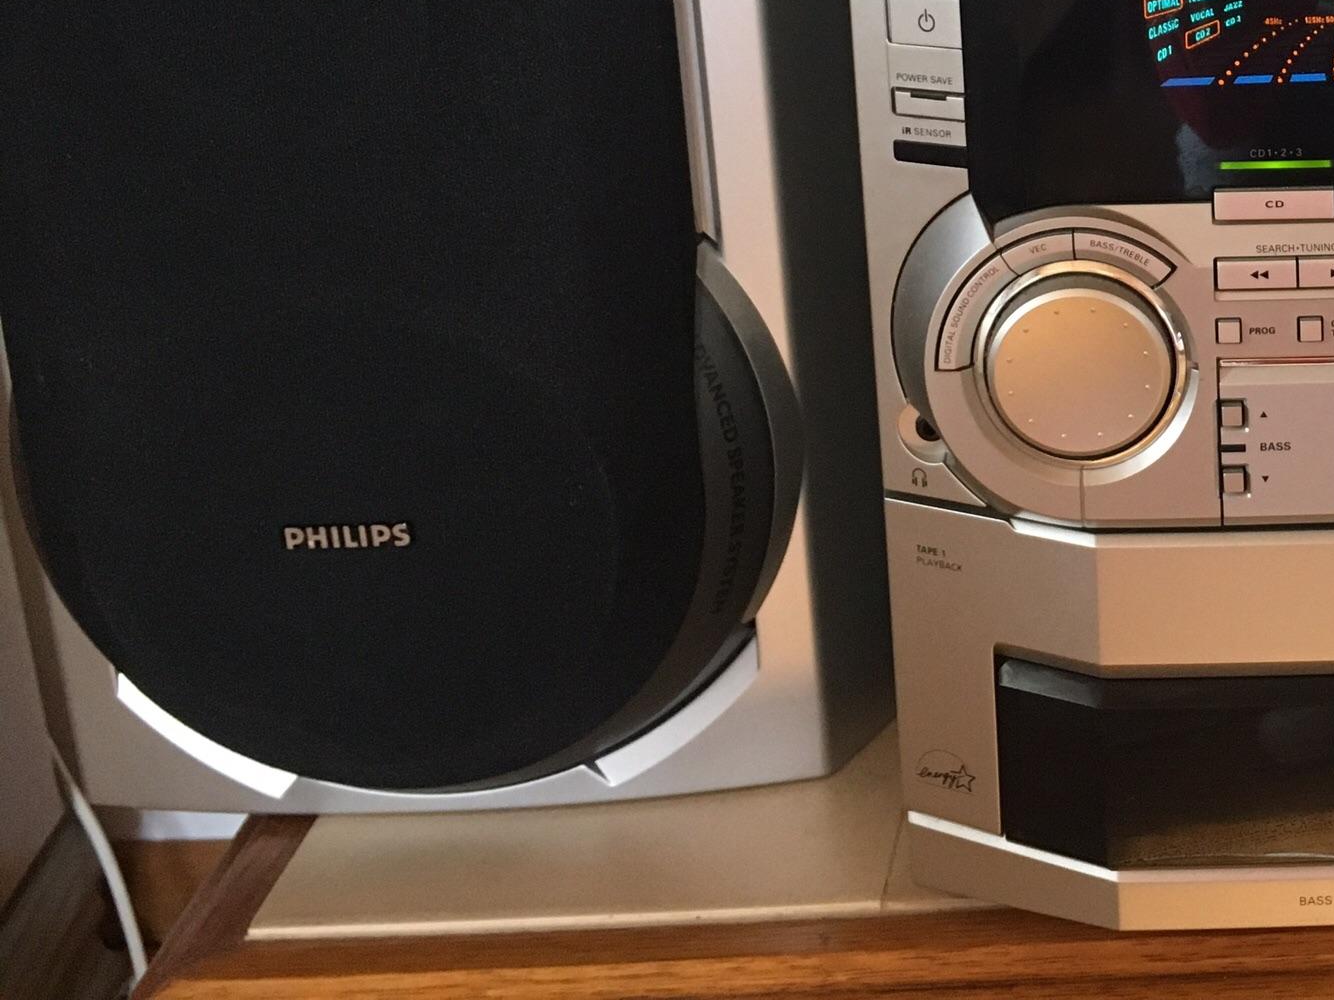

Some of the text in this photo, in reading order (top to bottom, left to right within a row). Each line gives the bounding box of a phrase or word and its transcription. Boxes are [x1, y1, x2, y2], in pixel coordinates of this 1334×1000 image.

[1148, 0, 1243, 40] CLASSIC VOCAL JAZZ
[1225, 17, 1236, 27] CD
[1195, 30, 1206, 41] CD
[1157, 47, 1167, 62] CD
[896, 73, 952, 85] POWER SAVE
[914, 128, 951, 138] SENSOR
[1265, 200, 1285, 209] CD
[1028, 244, 1047, 255] VEC
[944, 266, 1000, 364] DIGITAL SOUND CONTROL
[1249, 326, 1276, 336] PROG
[1260, 441, 1292, 452] BASS
[284, 523, 411, 550] PHILIPS
[916, 544, 938, 556] TAPE
[916, 556, 962, 571] PLAYBACK
[1299, 896, 1333, 906] BASS
